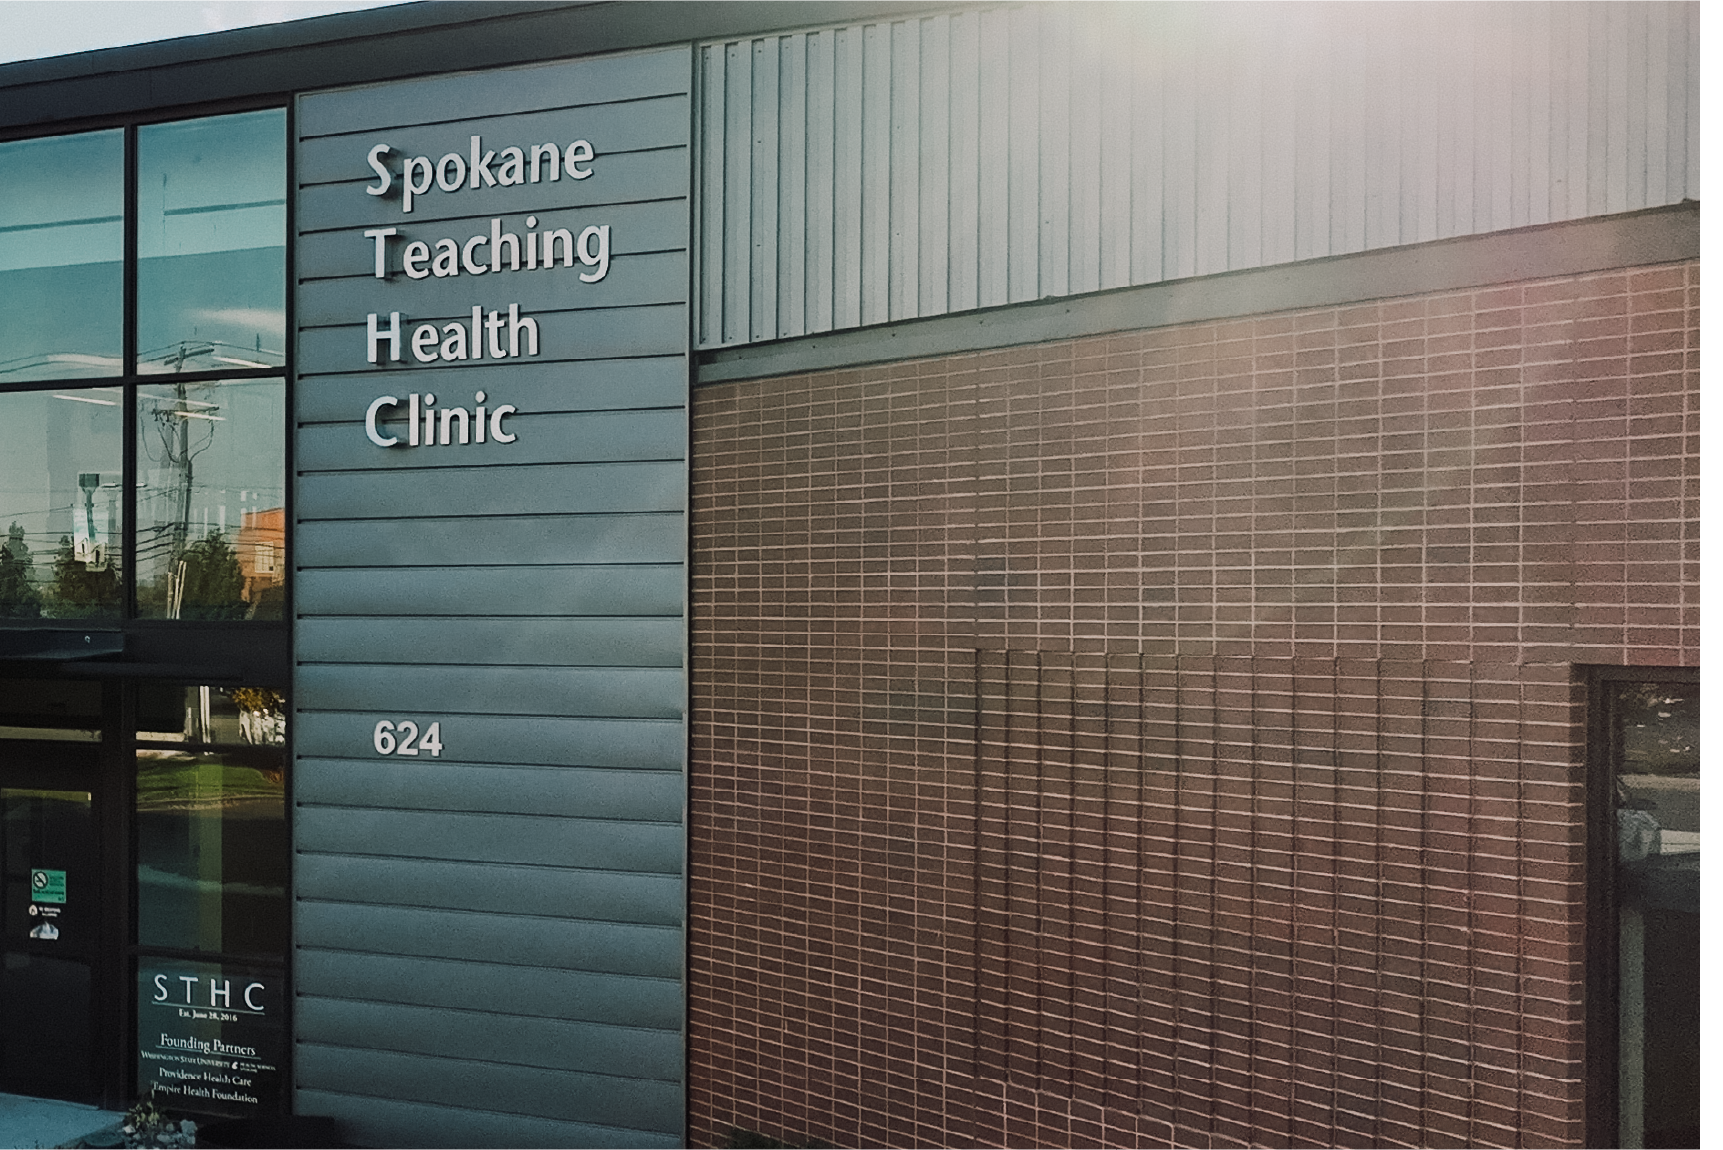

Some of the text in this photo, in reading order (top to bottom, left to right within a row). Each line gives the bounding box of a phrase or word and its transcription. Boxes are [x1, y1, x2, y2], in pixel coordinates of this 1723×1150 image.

[366, 135, 595, 213] Spokane
[364, 216, 611, 283] Teaching
[367, 303, 540, 363] Health
[365, 390, 518, 447] Clinic
[374, 720, 443, 757] 624
[154, 974, 266, 1011] STHC
[220, 1012, 238, 1022] 2016
[161, 1033, 256, 1056] Founding Partners
[153, 1082, 258, 1104] Empire Health Foundation
[159, 1067, 252, 1087] Providence Health Care
